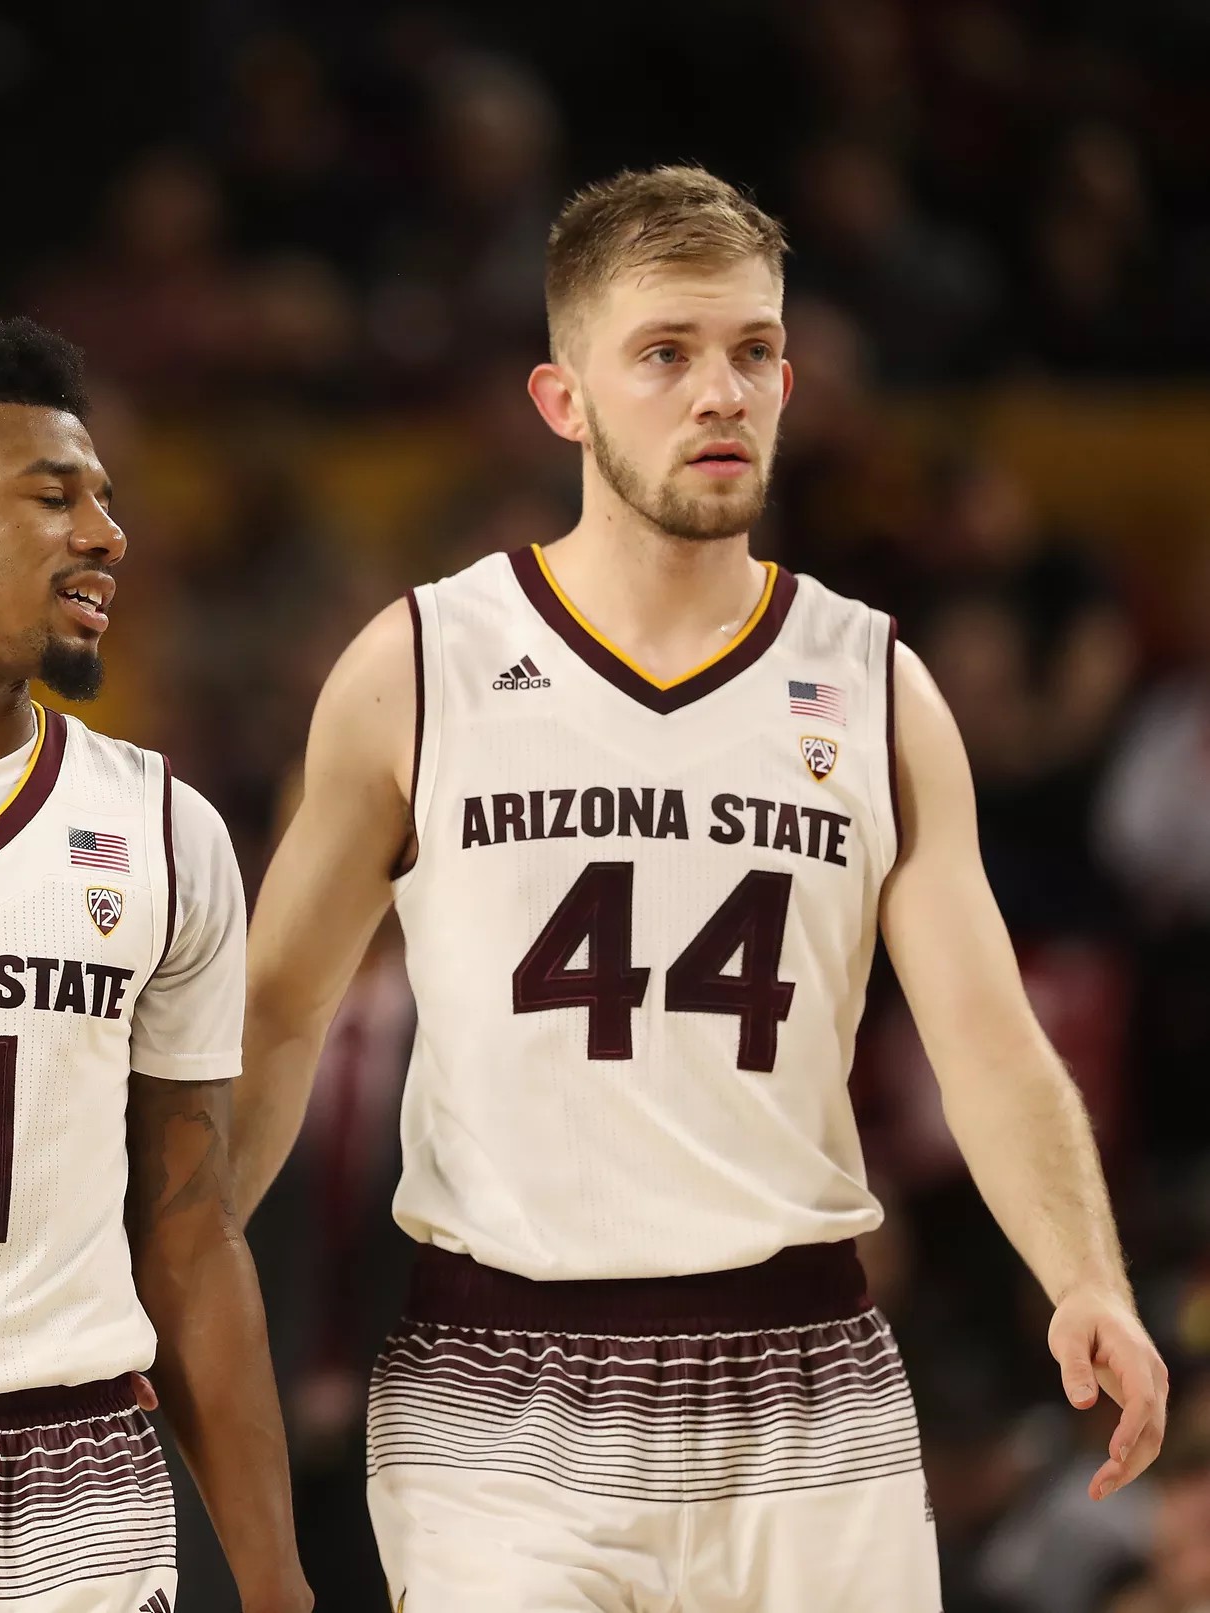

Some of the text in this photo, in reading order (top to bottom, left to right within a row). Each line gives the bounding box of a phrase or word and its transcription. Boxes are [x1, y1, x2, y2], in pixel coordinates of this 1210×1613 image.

[492, 678, 551, 691] adidas
[811, 756, 829, 774] 12
[461, 786, 853, 868] ARIZONA STATE
[87, 888, 122, 919] PAC
[96, 908, 115, 928] 12
[511, 861, 797, 1074] 44
